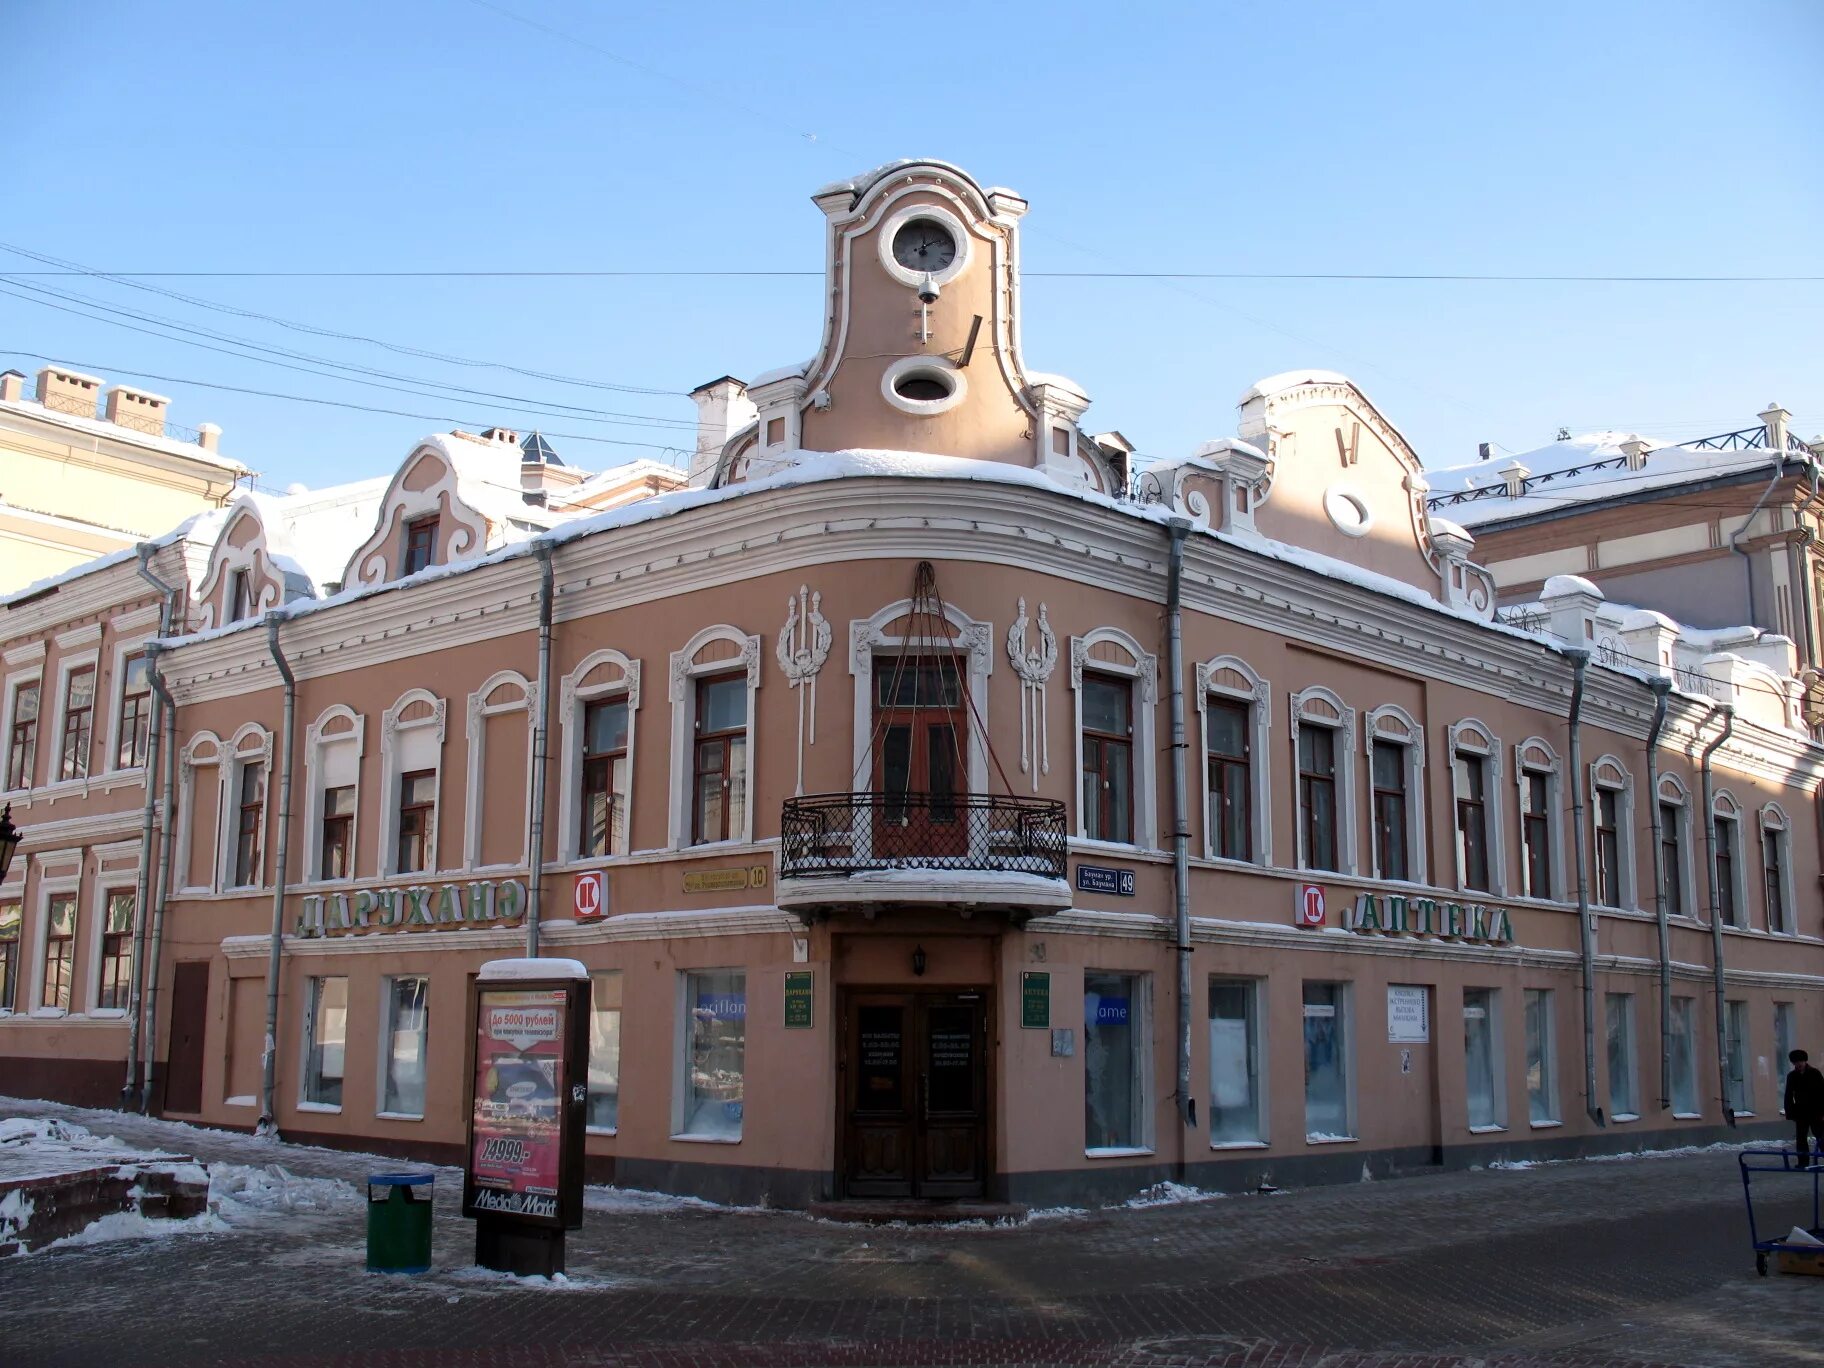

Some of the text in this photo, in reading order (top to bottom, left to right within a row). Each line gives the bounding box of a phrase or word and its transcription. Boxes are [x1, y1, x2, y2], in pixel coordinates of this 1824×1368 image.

[753, 869, 763, 885] 10
[1084, 870, 1104, 879] Бауман
[1122, 874, 1133, 891] 49
[1092, 879, 1115, 888] Баумана
[296, 879, 527, 938] ДАРУХАНӘ
[1353, 892, 1513, 942] АПТЕКА
[492, 1012, 554, 1027] До 5000 рублей
[475, 1188, 512, 1210] Media
[521, 1195, 557, 1217] Markt
